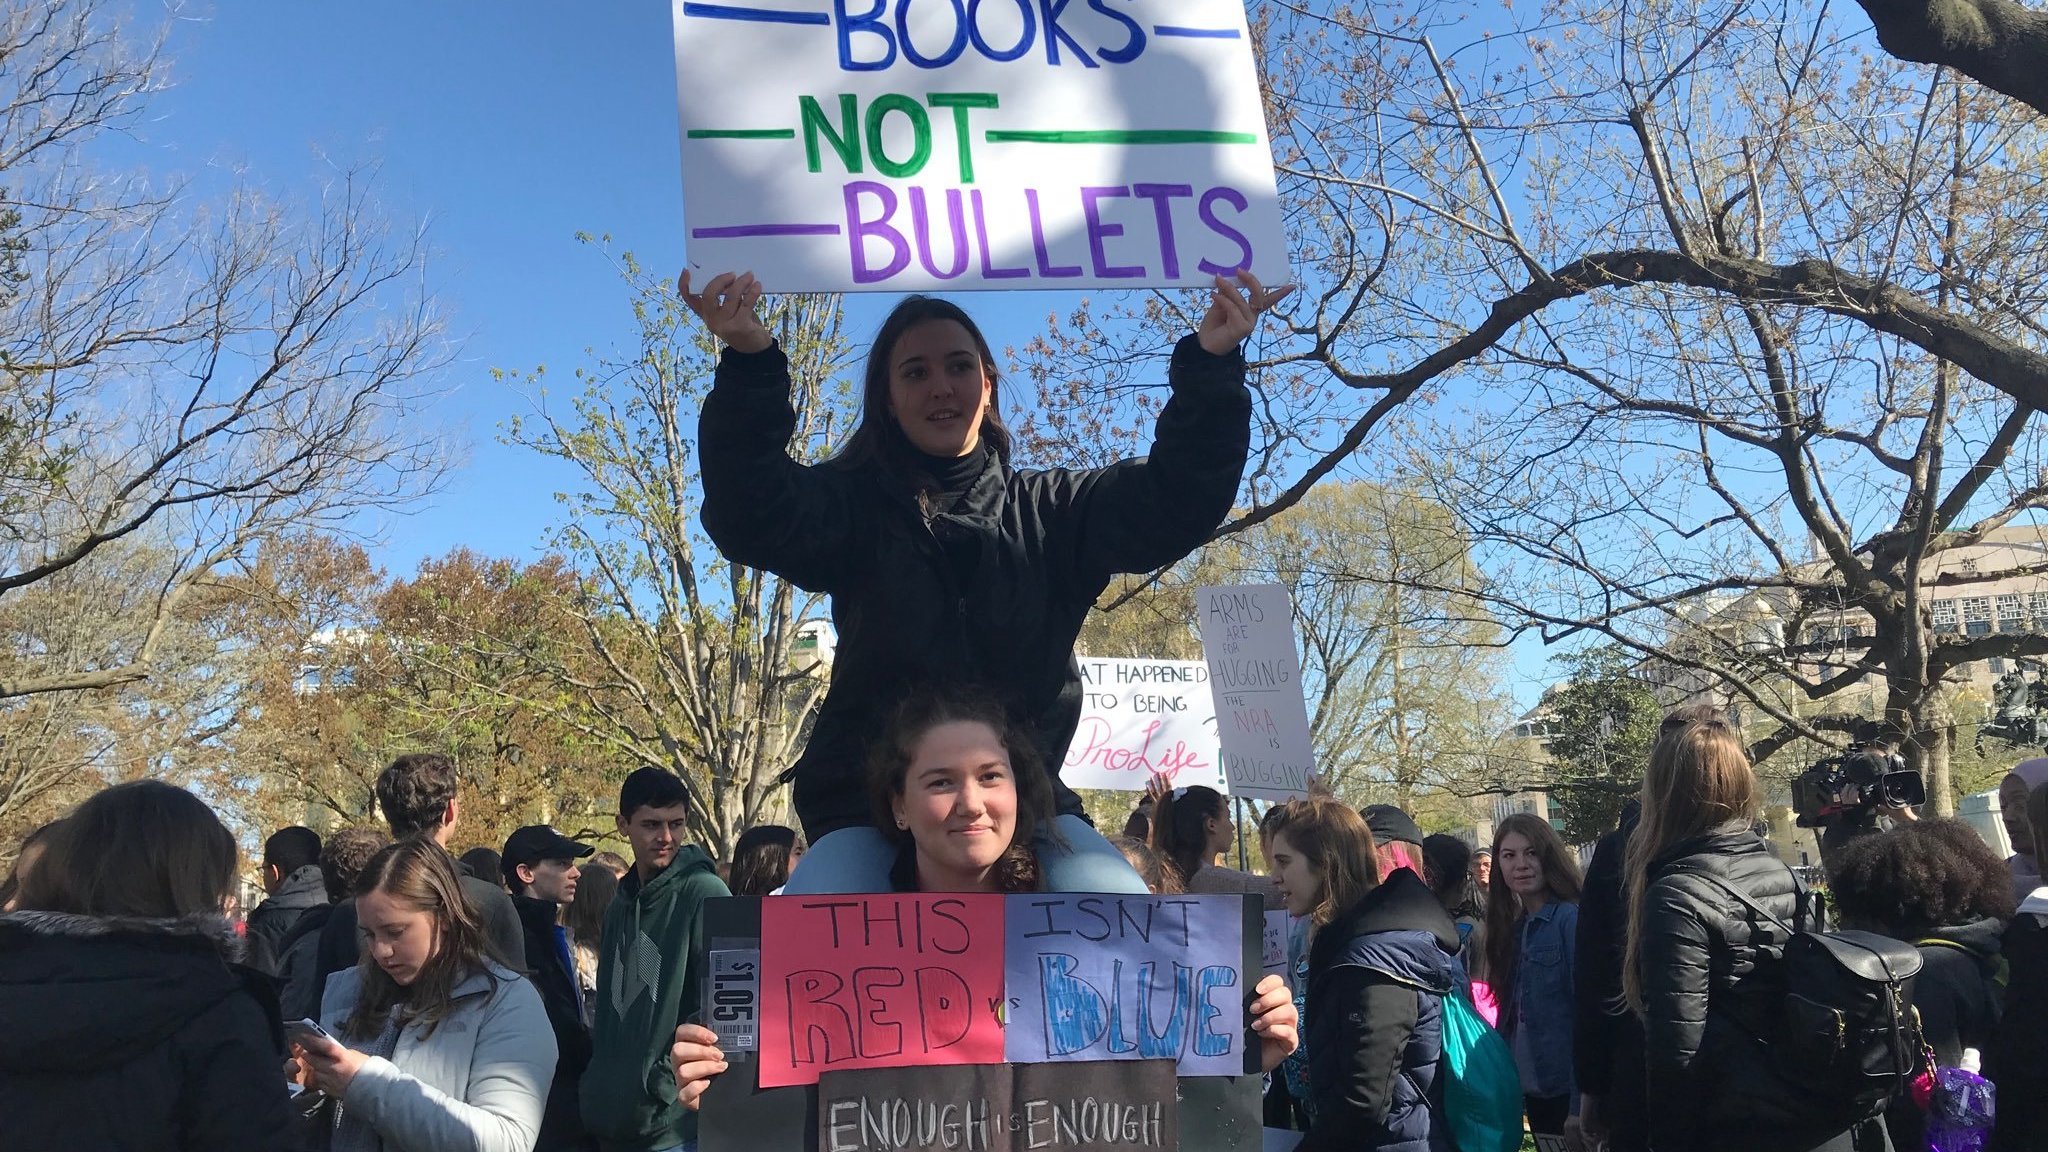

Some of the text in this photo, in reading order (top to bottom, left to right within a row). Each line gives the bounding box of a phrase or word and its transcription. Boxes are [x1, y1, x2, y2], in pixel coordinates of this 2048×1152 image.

[835, 0, 1147, 72] BOOKS
[799, 93, 999, 184] NOT
[842, 181, 1254, 284] BULLETS
[1209, 593, 1264, 624] ARMS
[1222, 642, 1240, 654] FOR
[1226, 625, 1248, 641] ARE
[1080, 663, 1208, 685] AT HAPPENED
[1207, 658, 1289, 689] HUGGING
[1085, 693, 1188, 713] TO BEING
[1223, 695, 1246, 707] THE
[1233, 708, 1279, 736] NRA
[802, 899, 971, 954] THIS
[1024, 898, 1200, 947] ISN'T
[713, 962, 755, 1022] $1.05
[785, 966, 972, 1069] RED
[1037, 952, 1238, 1067] BLUE
[829, 1096, 989, 1152] ENOUGH
[1024, 1096, 1162, 1149] ENOUGH
